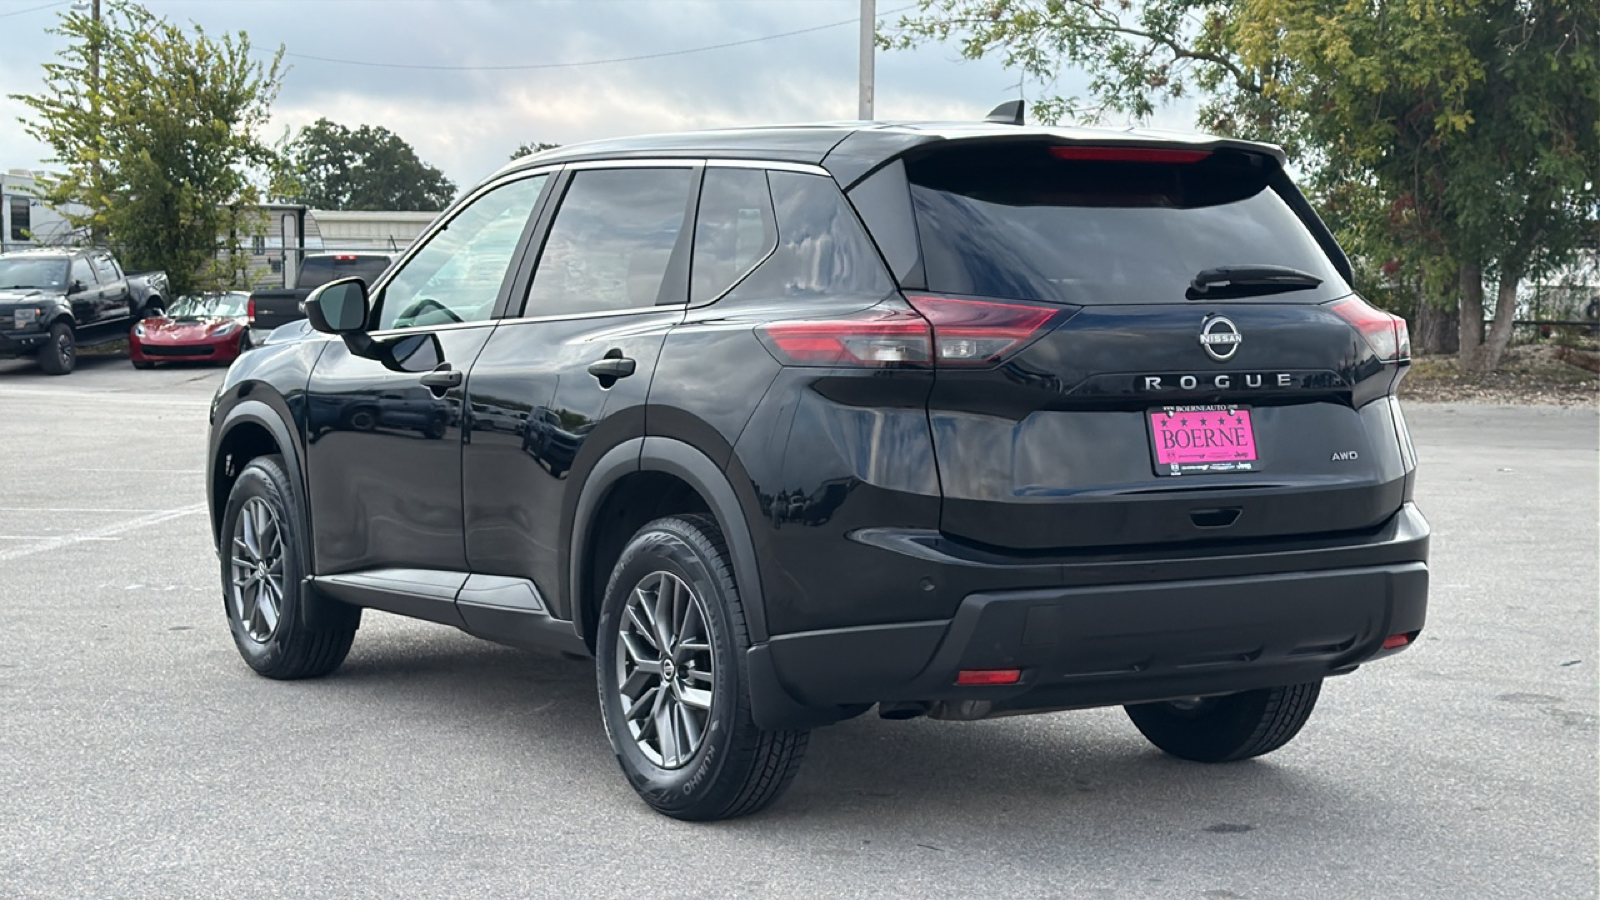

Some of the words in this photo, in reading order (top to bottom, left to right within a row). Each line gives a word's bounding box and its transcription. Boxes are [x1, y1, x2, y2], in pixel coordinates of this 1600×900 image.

[1200, 334, 1241, 343] NISSAN
[1145, 374, 1291, 389] ROGUE
[1161, 427, 1248, 449] BOERNE
[1332, 451, 1358, 461] AWD
[683, 744, 716, 795] KUMHO
